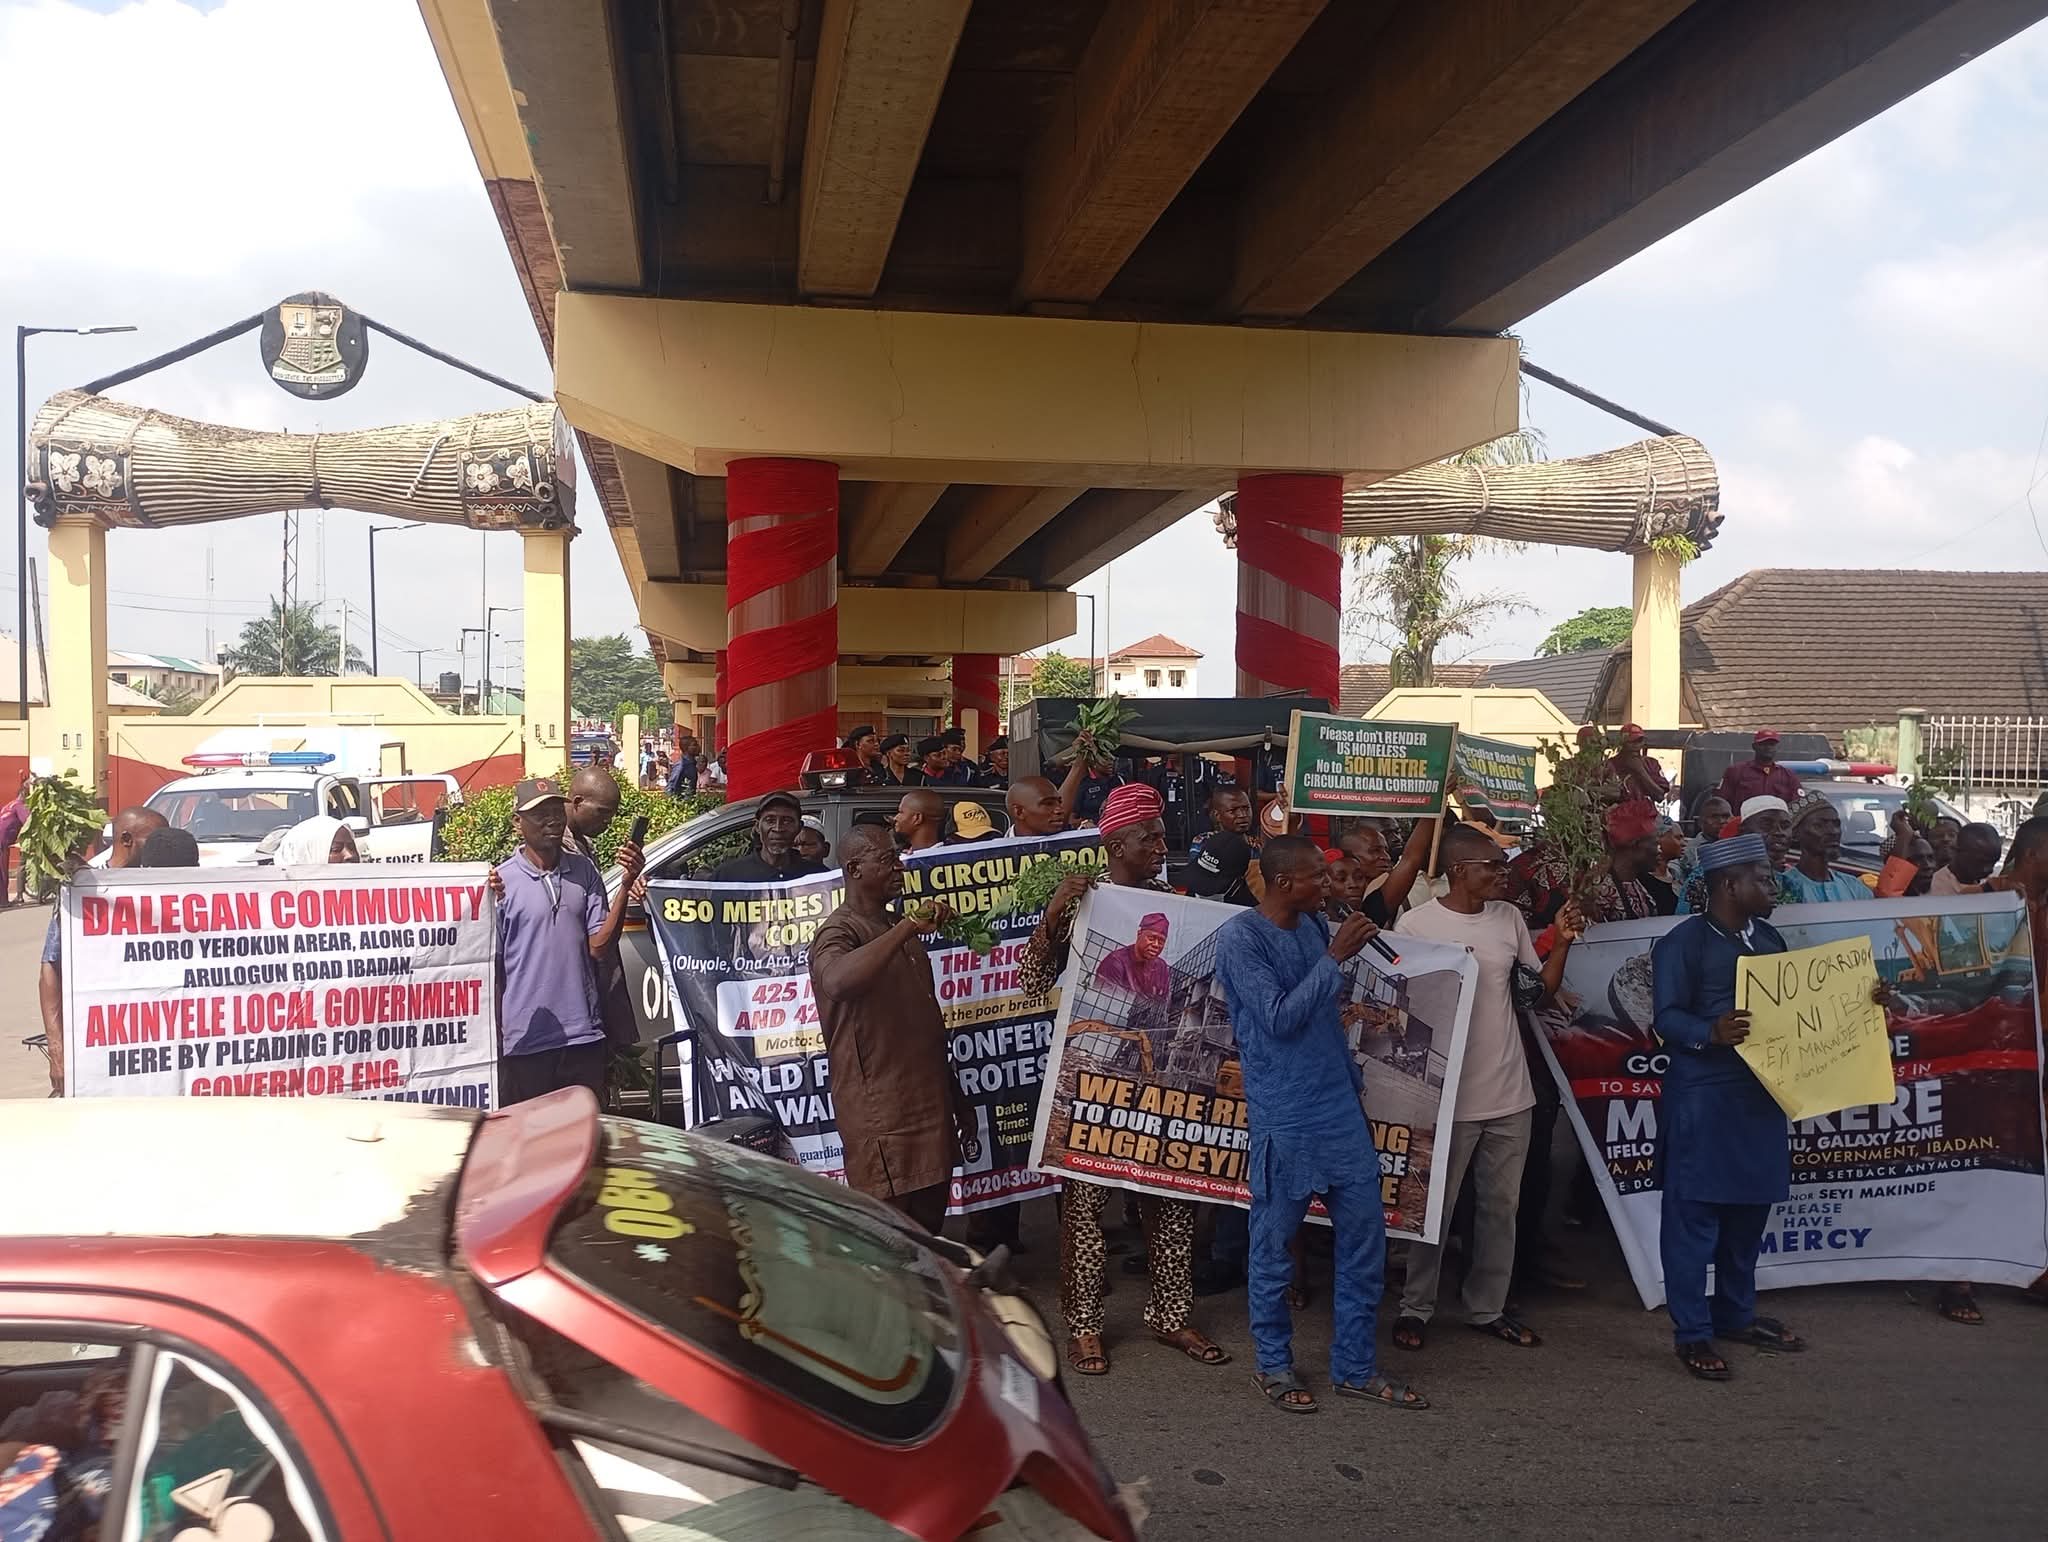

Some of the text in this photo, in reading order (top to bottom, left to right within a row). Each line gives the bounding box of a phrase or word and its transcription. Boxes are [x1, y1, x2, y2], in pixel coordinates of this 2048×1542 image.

[1320, 726, 1427, 746] Please don't RENDER
[1336, 741, 1407, 758] US HOMELESS
[1303, 773, 1439, 793] CIRCULAR ROAD CORRIDOR
[1316, 756, 1427, 778] No to 500 METRE
[82, 885, 485, 937] DALEGAN COMMUNITY
[663, 898, 714, 923] 850
[722, 893, 823, 924] METRES
[123, 926, 458, 963] ARORO YEROKUN AREAR, ALONG OJOO
[183, 957, 414, 989] ARULOGUN ROAD IBADAN.
[752, 981, 798, 1005] 425
[940, 951, 981, 976] THE
[1744, 960, 1799, 1012] NO
[85, 980, 483, 1048] AKINYELE LOCAL GOVERNMENT
[734, 1008, 787, 1031] AND
[940, 976, 973, 1001] ON
[765, 1035, 812, 1051] Motto:
[951, 1010, 973, 1021] the
[975, 1004, 1005, 1020] poor
[1796, 1004, 1823, 1039] NI
[108, 1021, 467, 1077] HERE BY PLEADING FOR OUR ABLE
[705, 1055, 804, 1094] WORLD
[947, 1020, 1054, 1063] ONFER
[191, 1058, 405, 1098] GOVERNOR ENG.
[1599, 1081, 1624, 1093] TO
[1912, 1062, 1932, 1075] IN
[995, 1102, 1028, 1118] Date:
[1079, 1073, 1135, 1108] WE
[1138, 1084, 1206, 1122] ARE
[996, 1117, 1029, 1132] Time:
[1072, 1100, 1105, 1124] TO
[1109, 1108, 1162, 1136] OUR
[1167, 1119, 1250, 1151] GOVER
[1068, 1123, 1241, 1179] ENGR SEYI
[1606, 1142, 1655, 1160] IFELO
[1817, 1131, 1891, 1149] GALAXY
[1894, 1124, 1943, 1144] ZONE
[1792, 1144, 1919, 1166] GOVERNMENT,
[1927, 1136, 2000, 1154] IBADAN.
[1071, 1156, 1094, 1167] OGO
[1094, 1161, 1129, 1174] OLUWA
[1130, 1167, 1174, 1184] QUARTER
[1174, 1175, 1209, 1190] ENIOSA
[1826, 1165, 1897, 1180] SETBACK
[1904, 1157, 1981, 1173] ANYMORE
[1818, 1188, 1854, 1200] SEYI
[1859, 1181, 1936, 1199] MAKINDE
[1776, 1203, 1842, 1216] PLEASE
[1783, 1216, 1833, 1228] HAVE
[1760, 1228, 1873, 1254] MERCY
